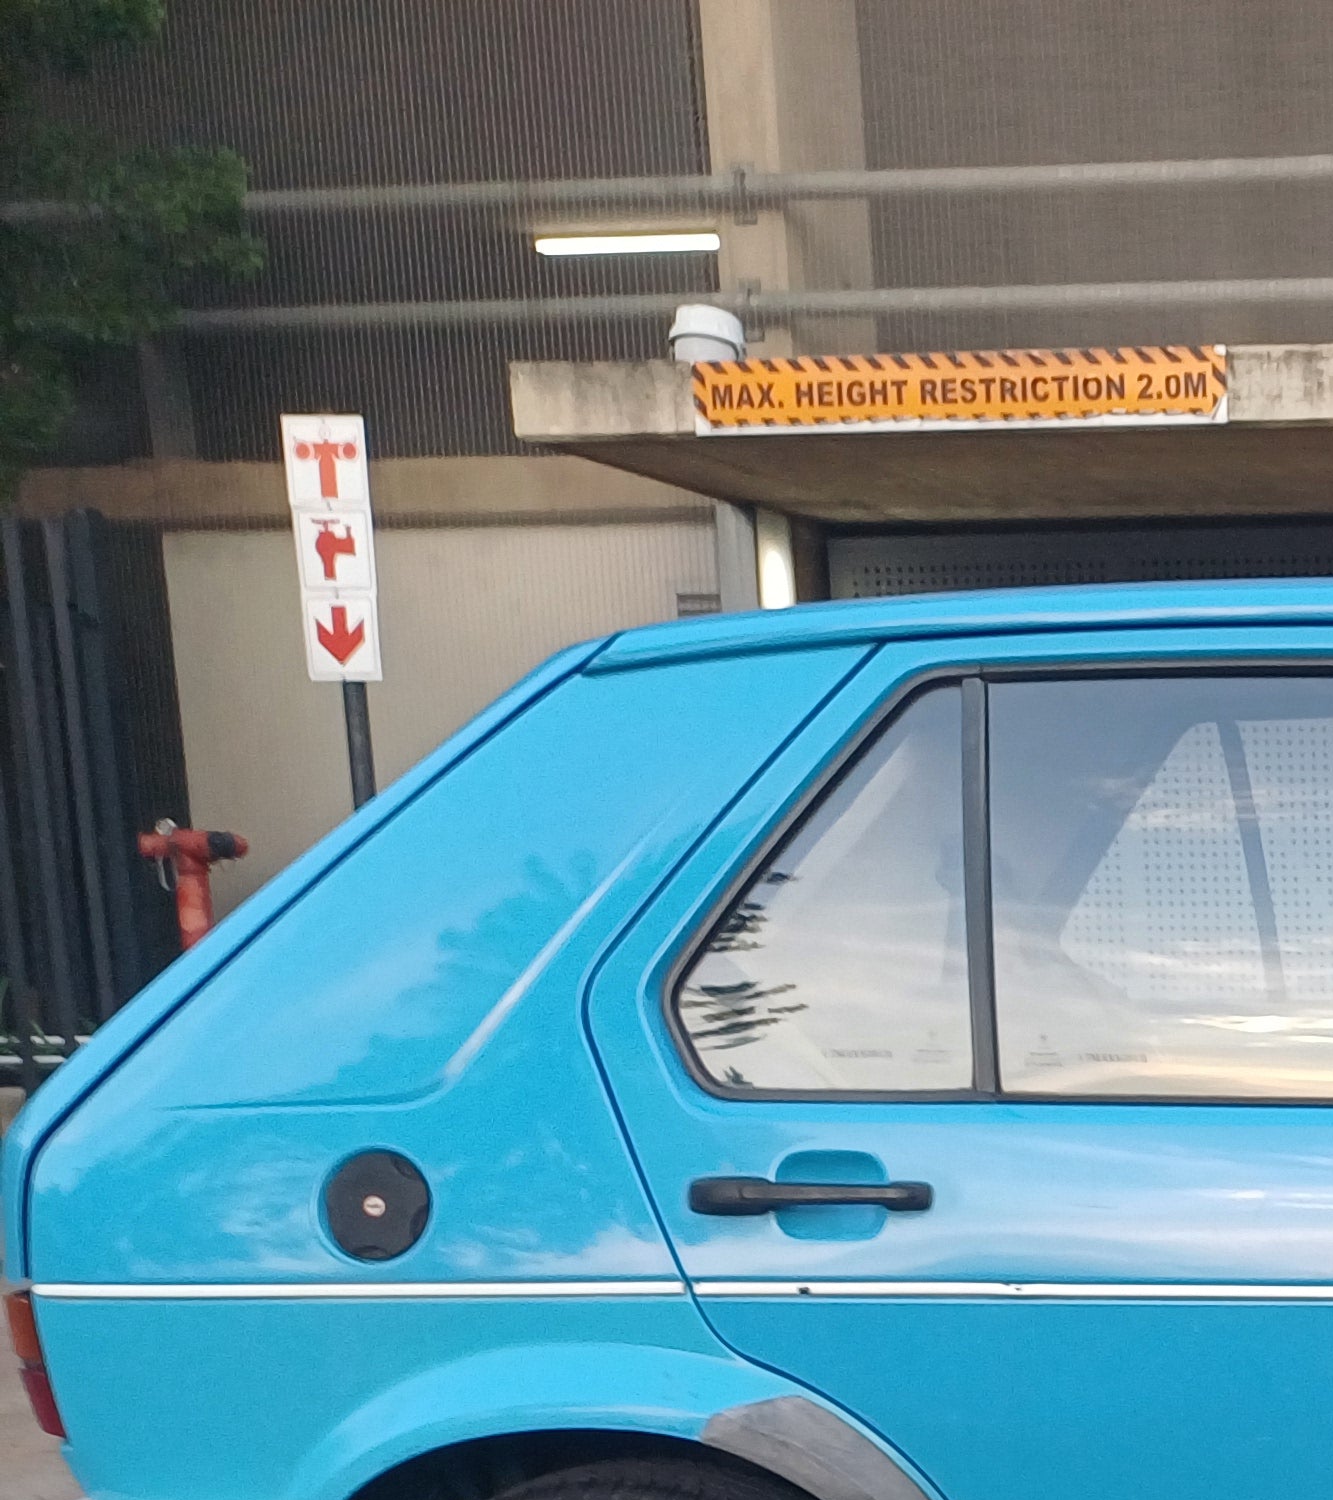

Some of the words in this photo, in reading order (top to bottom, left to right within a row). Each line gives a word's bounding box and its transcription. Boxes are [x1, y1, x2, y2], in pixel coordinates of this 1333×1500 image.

[710, 383, 785, 411] MAX.
[795, 379, 909, 408] HEIGHT
[919, 374, 1127, 406] RESTRICTION
[1136, 372, 1208, 401] 2.0M
